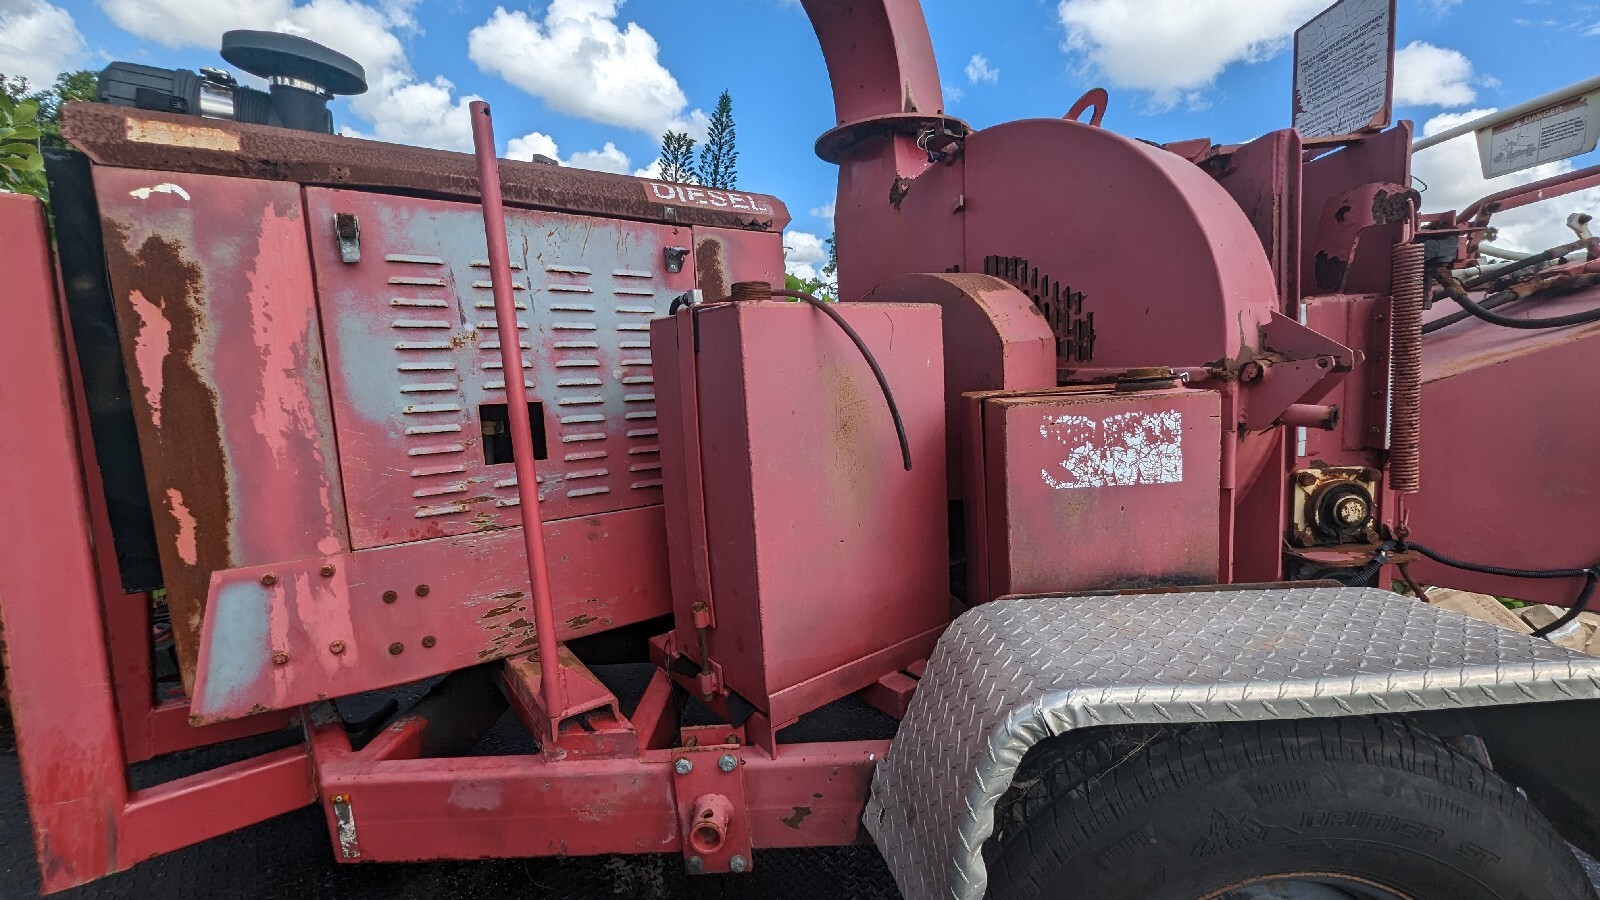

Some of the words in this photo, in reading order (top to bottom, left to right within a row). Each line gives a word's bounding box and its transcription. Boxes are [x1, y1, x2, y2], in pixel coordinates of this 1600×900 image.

[1524, 106, 1563, 124] DANGER
[650, 182, 767, 212] DIESEL
[1299, 809, 1445, 844] RAINIER
[1455, 840, 1501, 866] ST
